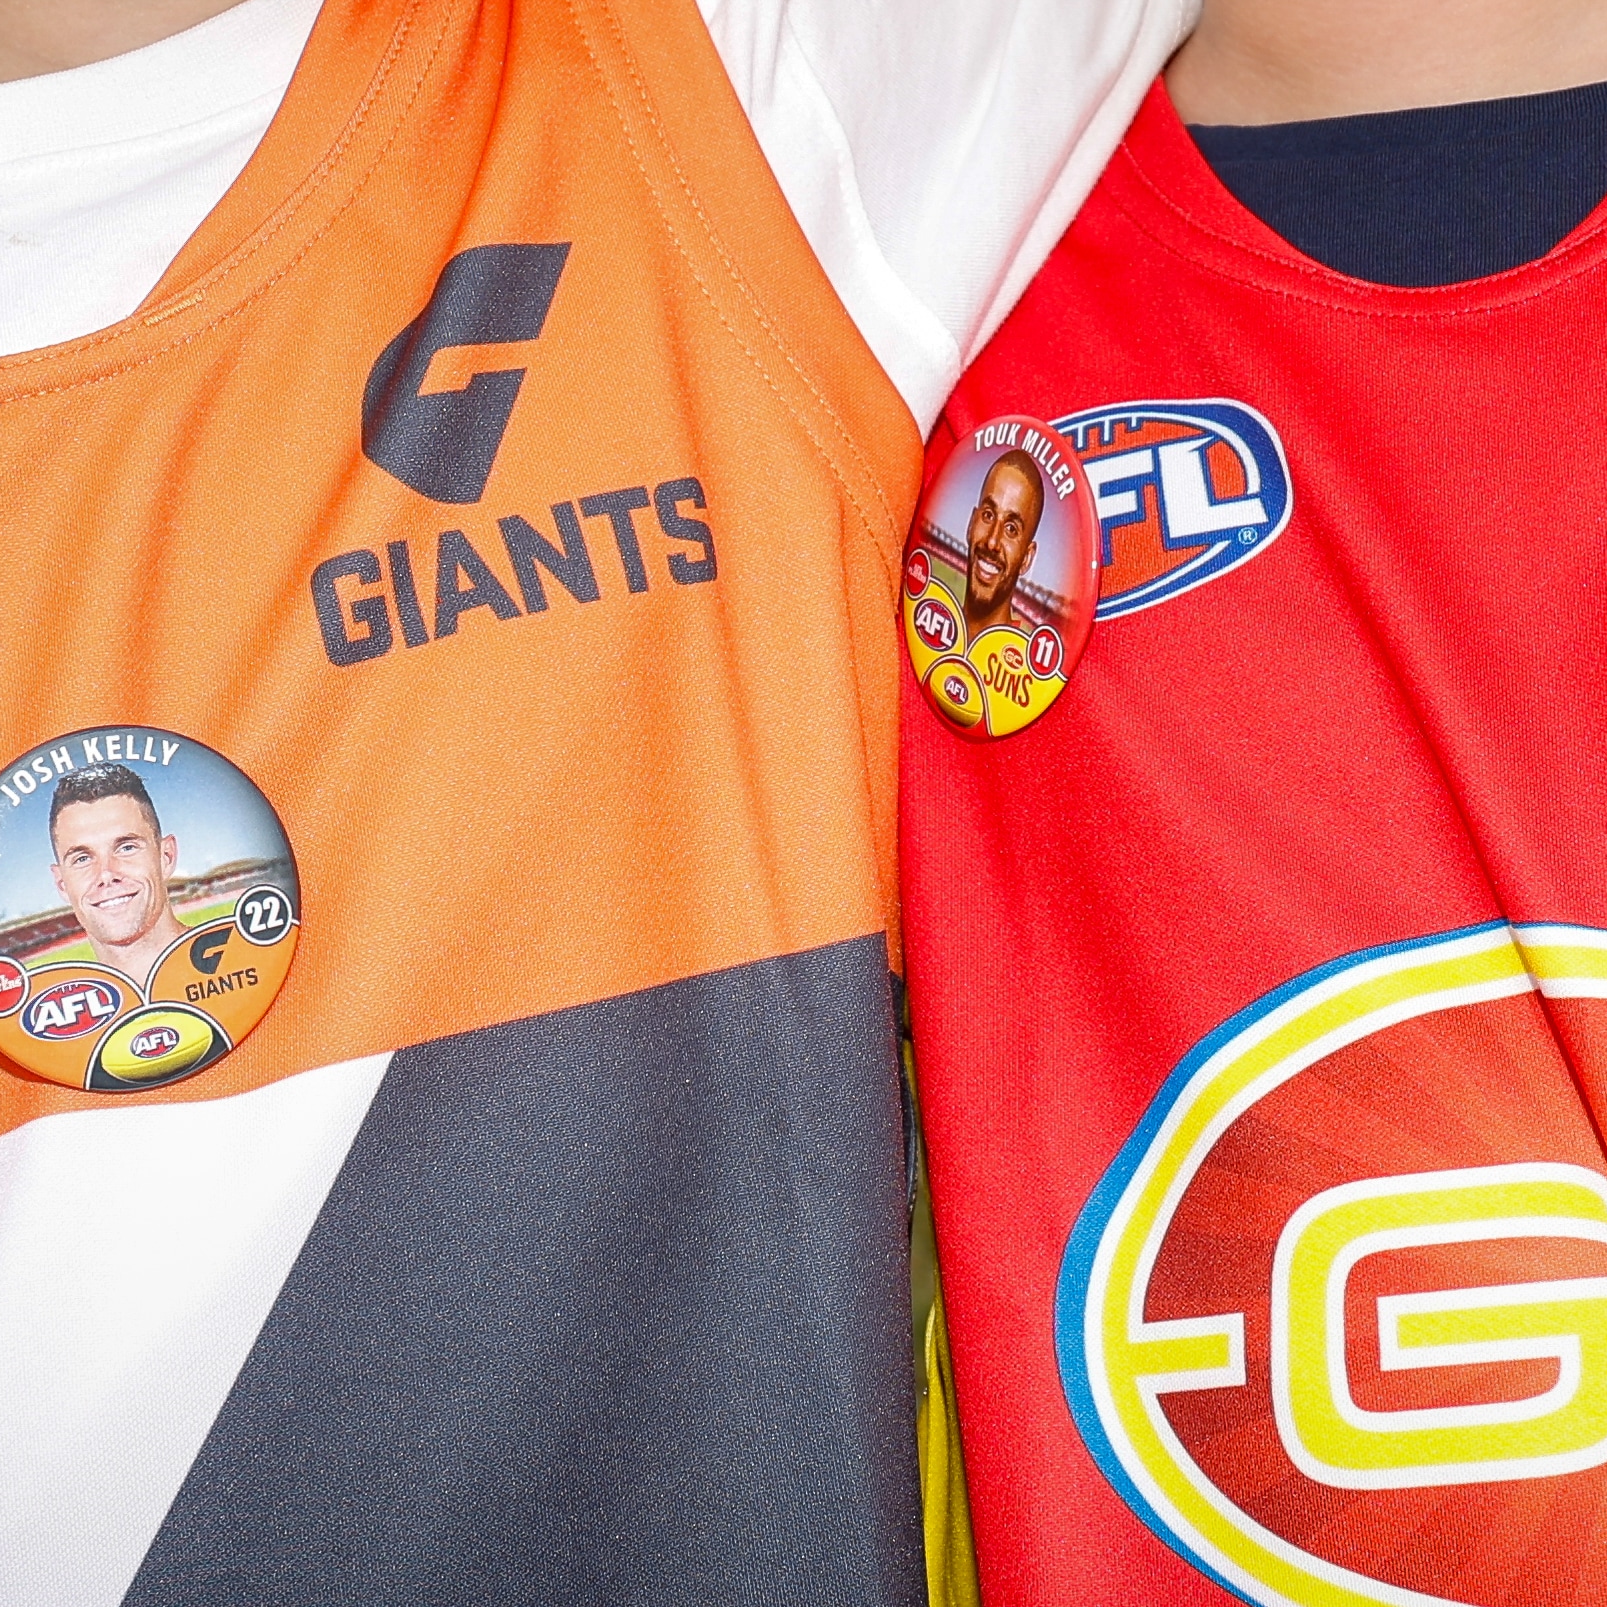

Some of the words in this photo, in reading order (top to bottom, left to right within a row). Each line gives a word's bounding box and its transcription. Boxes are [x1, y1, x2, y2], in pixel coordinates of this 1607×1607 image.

[975, 423, 1021, 452] TOUK
[1022, 429, 1076, 501] MILLER
[1084, 436, 1269, 540] FL
[310, 476, 718, 667] GIANTS
[915, 606, 953, 647] AFL
[1035, 636, 1054, 668] 11
[945, 680, 966, 703] AFL
[983, 652, 1033, 707] SUNS
[0, 746, 75, 807] JOSH
[82, 734, 179, 766] KELLY
[244, 897, 285, 934] 22
[185, 968, 259, 1004] GIANTS
[33, 988, 115, 1034] AFL
[134, 1030, 177, 1057] AFL
